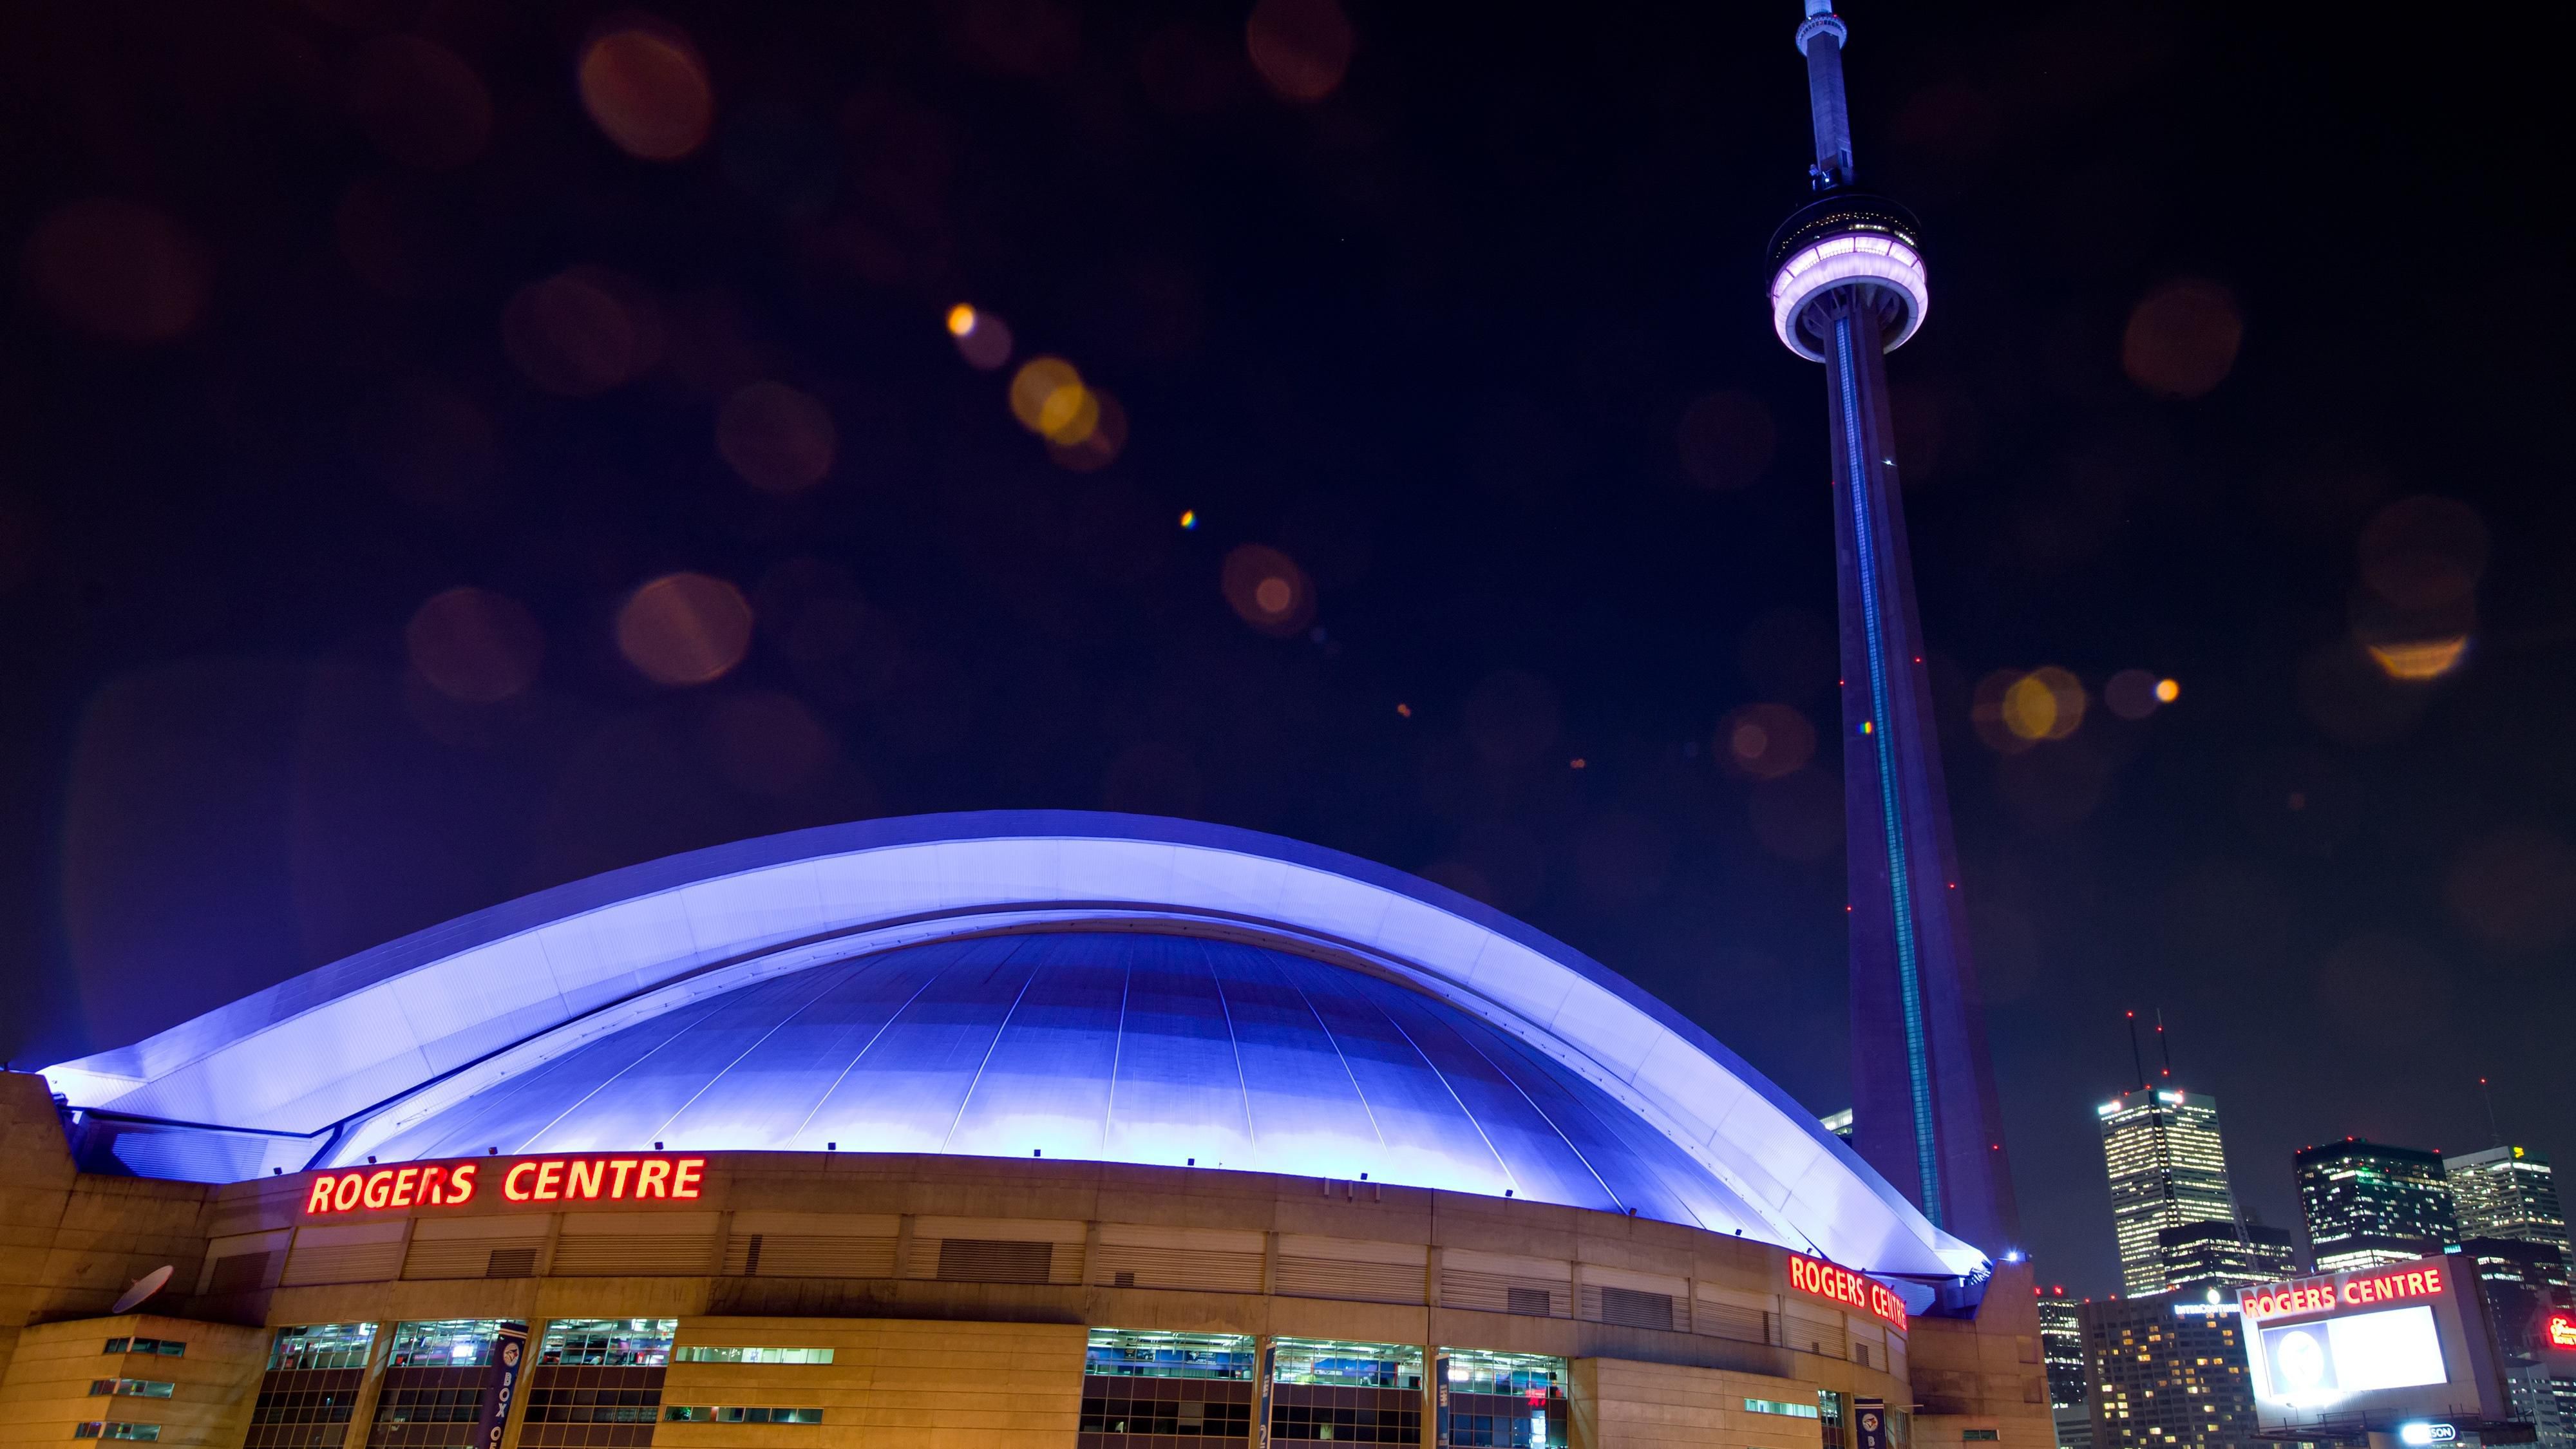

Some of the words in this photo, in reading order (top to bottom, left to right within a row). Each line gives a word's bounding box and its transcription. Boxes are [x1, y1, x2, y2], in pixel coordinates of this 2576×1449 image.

[307, 1165, 476, 1214] ROGERS
[504, 1159, 705, 1201] CENTRE
[1791, 1256, 1865, 1308] ROGERS
[1872, 1285, 1907, 1331] CENTRE
[2244, 1286, 2336, 1319] ROGERS
[2343, 1269, 2441, 1304] CENTRE
[495, 1372, 512, 1417] BOX
